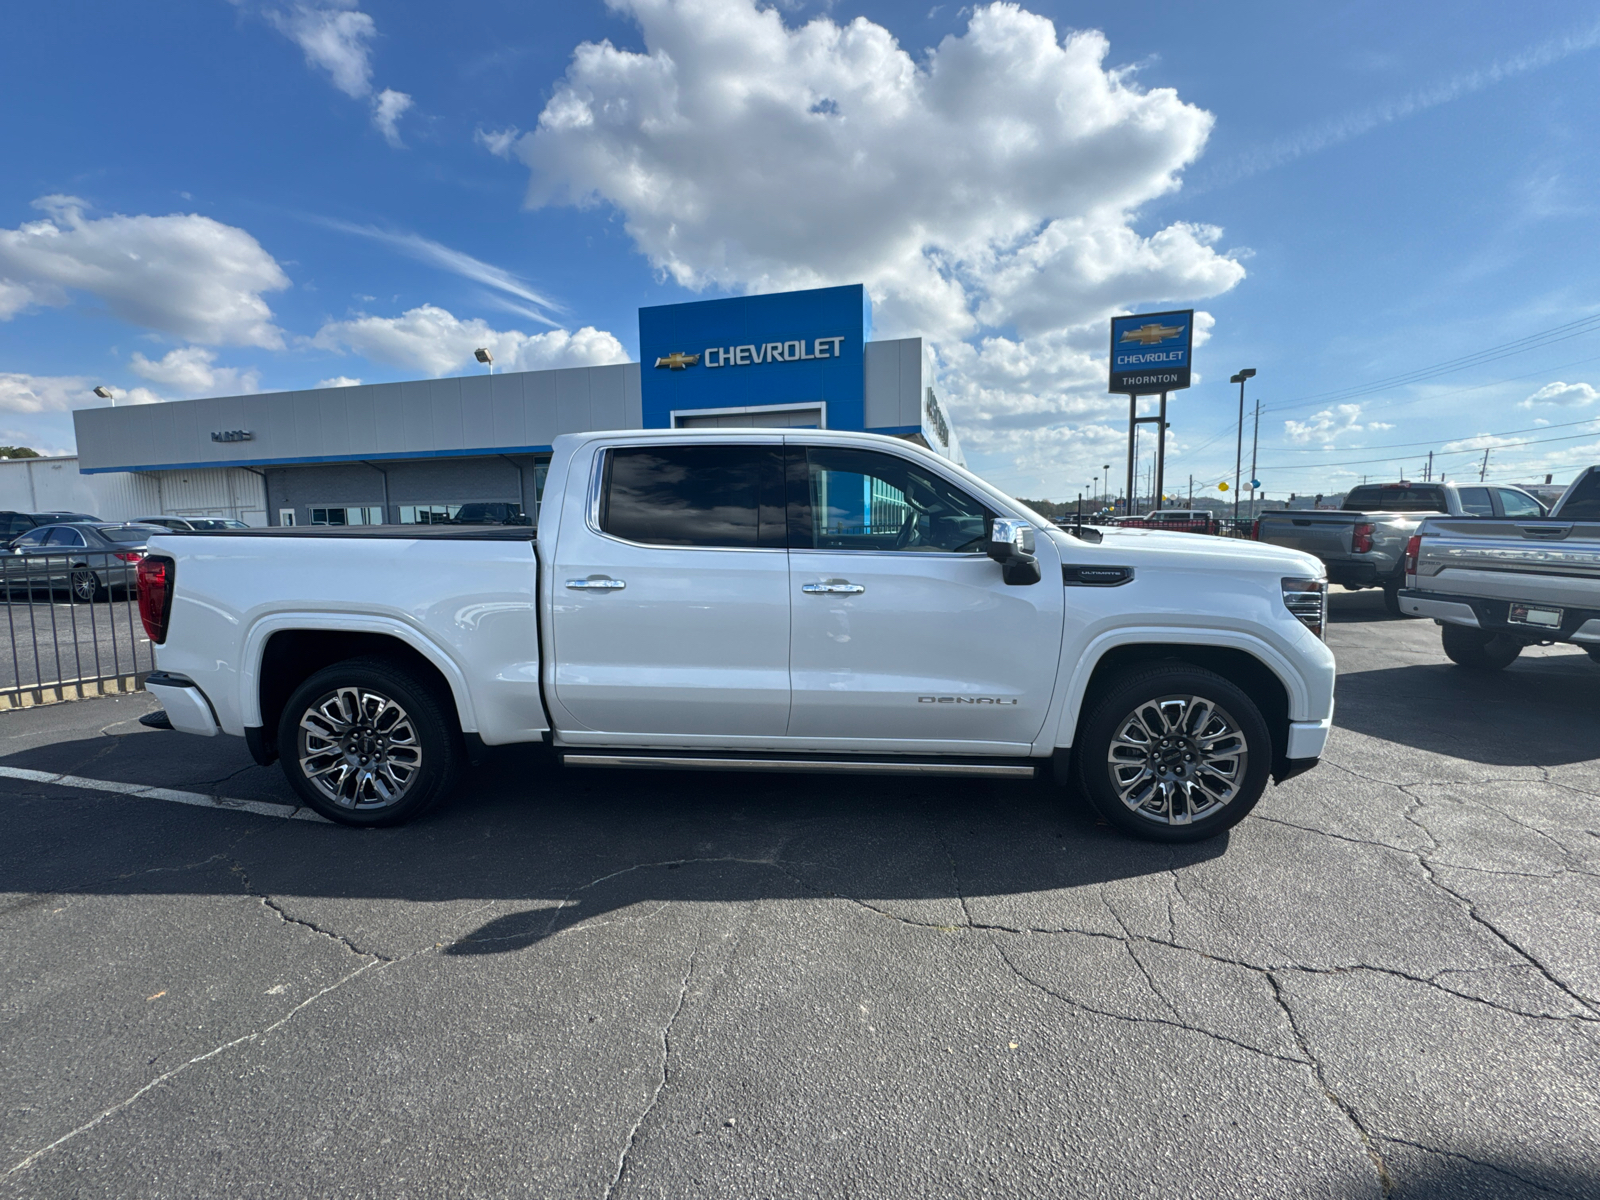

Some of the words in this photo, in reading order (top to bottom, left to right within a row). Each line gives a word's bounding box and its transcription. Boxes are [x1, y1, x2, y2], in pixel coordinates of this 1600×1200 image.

[704, 336, 845, 368] CHEVROLET
[1117, 350, 1184, 365] CHEVROLET
[1122, 374, 1178, 385] THORNTON
[917, 695, 1018, 705] DENALI
